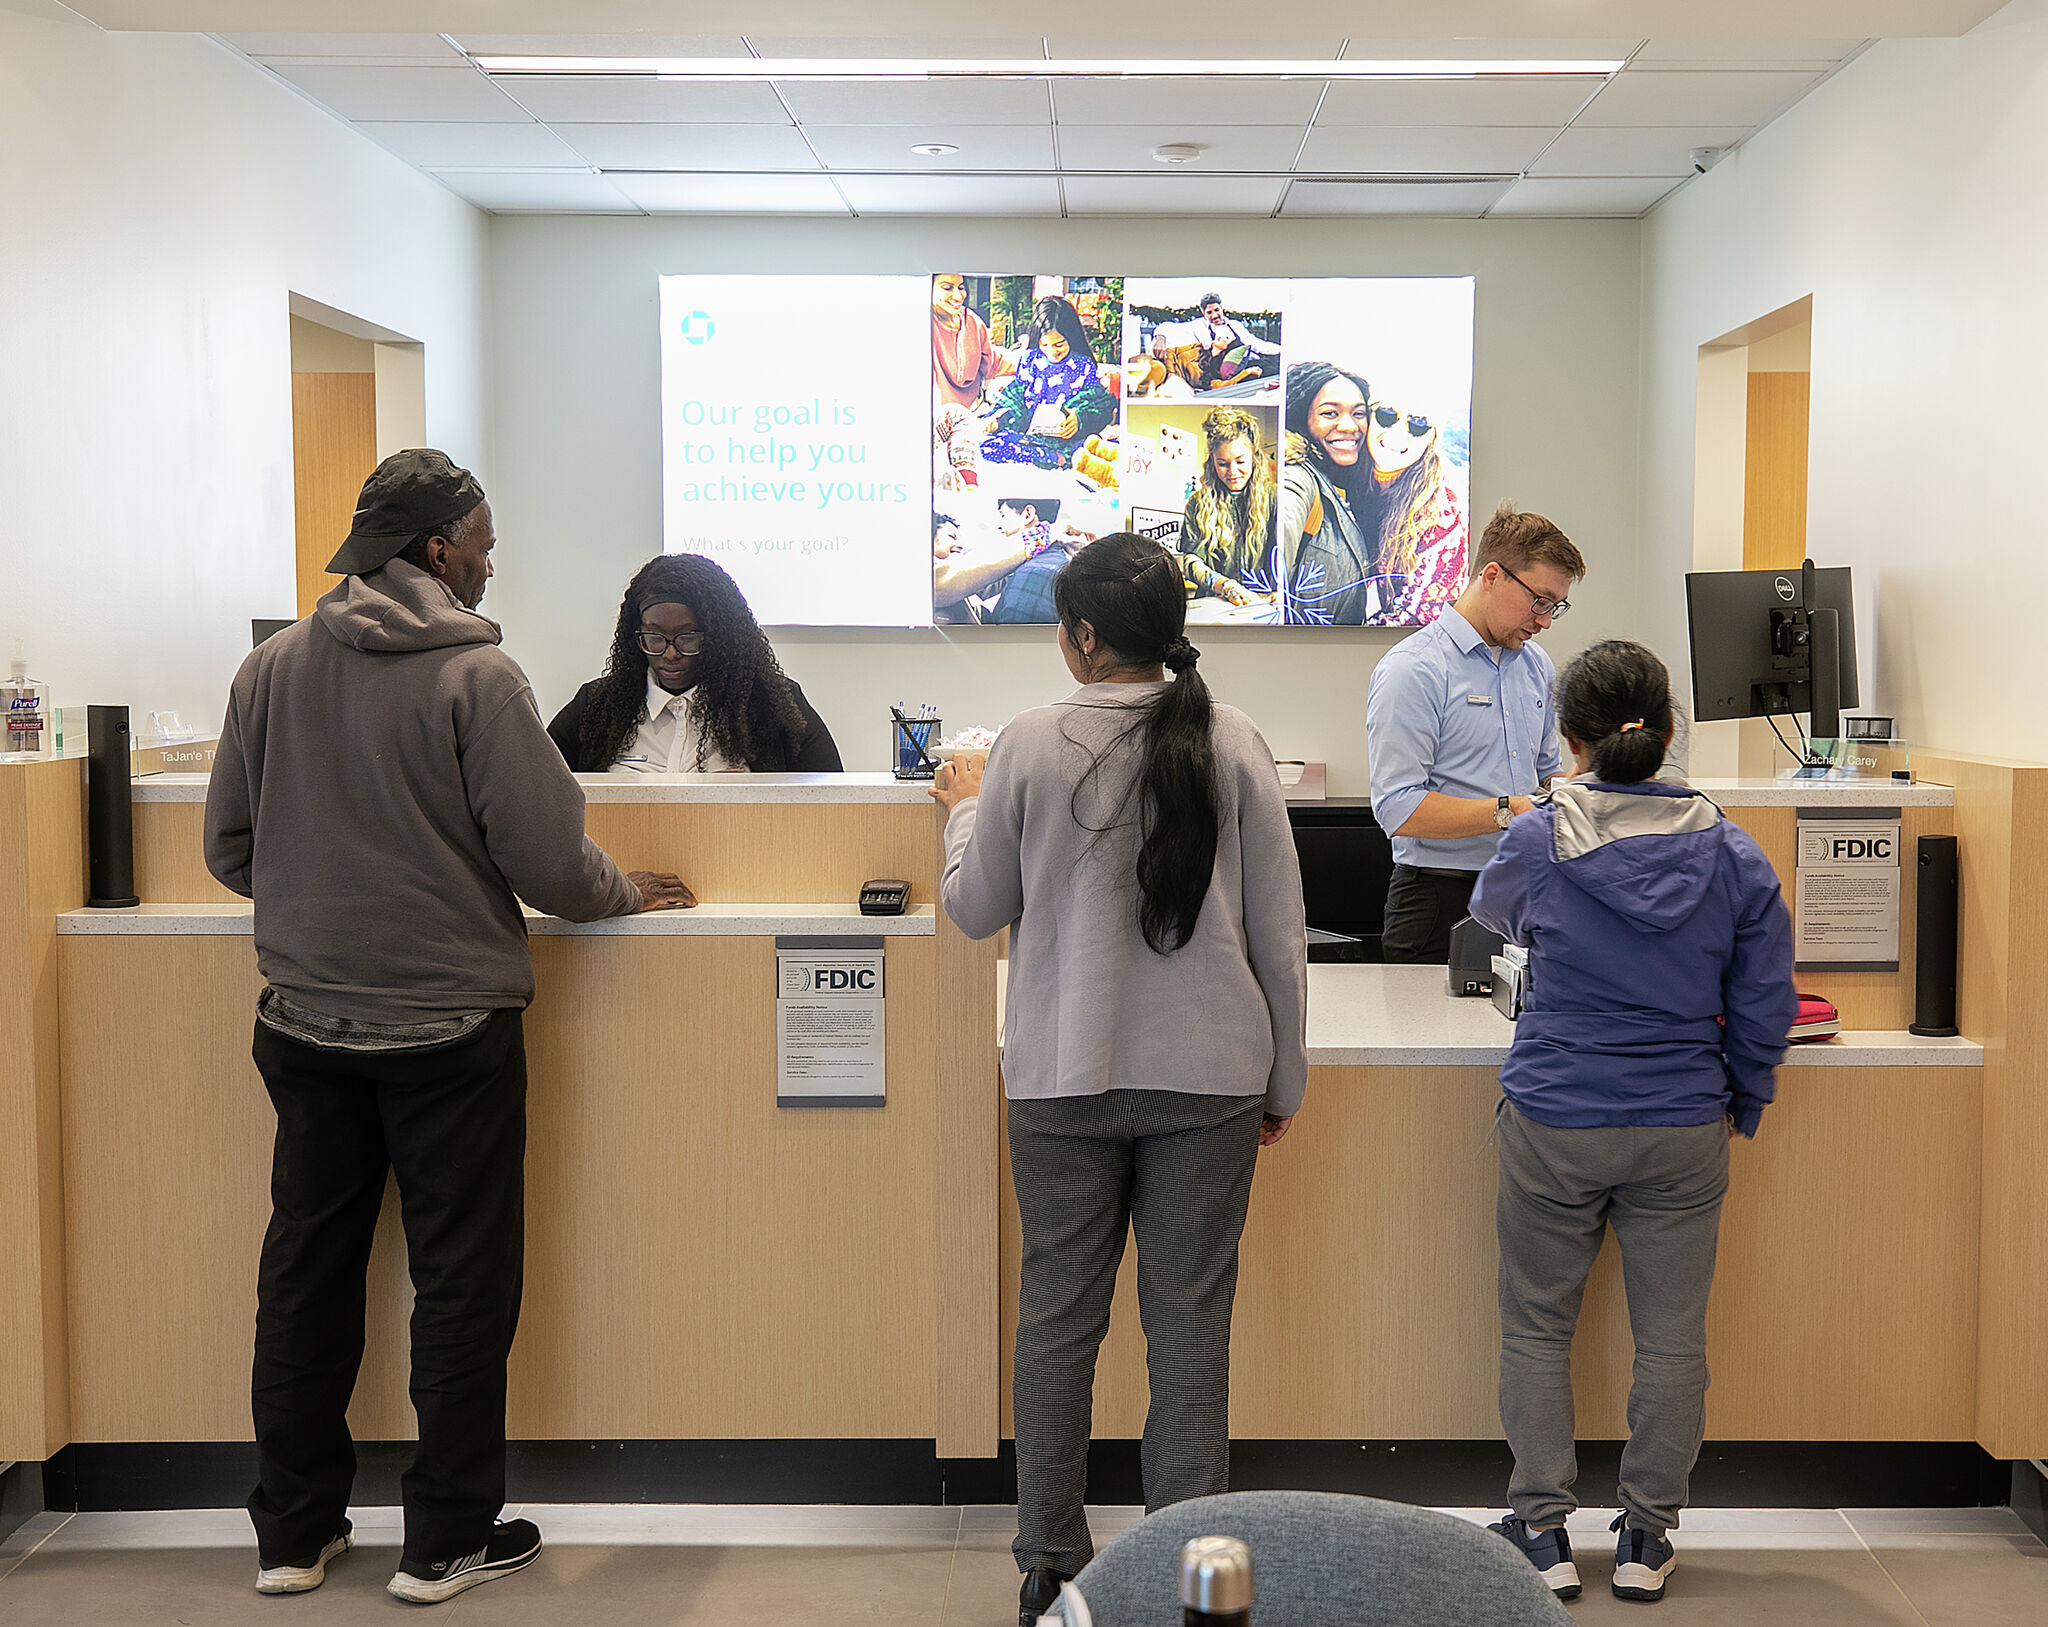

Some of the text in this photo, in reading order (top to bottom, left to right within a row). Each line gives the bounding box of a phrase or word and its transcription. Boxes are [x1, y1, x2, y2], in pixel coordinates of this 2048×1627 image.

[682, 398, 857, 434] Our goal is
[683, 436, 866, 472] to help you
[1125, 455, 1152, 475] JOY
[683, 475, 908, 510] achieve yours
[1142, 521, 1178, 539] PRINT
[683, 536, 849, 555] What's your goal?
[1778, 584, 1793, 592] DELL
[160, 751, 203, 762] TaJan'e
[1804, 754, 1878, 769] Zachary Carey
[1832, 839, 1891, 859] FDIC
[815, 969, 876, 990] FDIC
